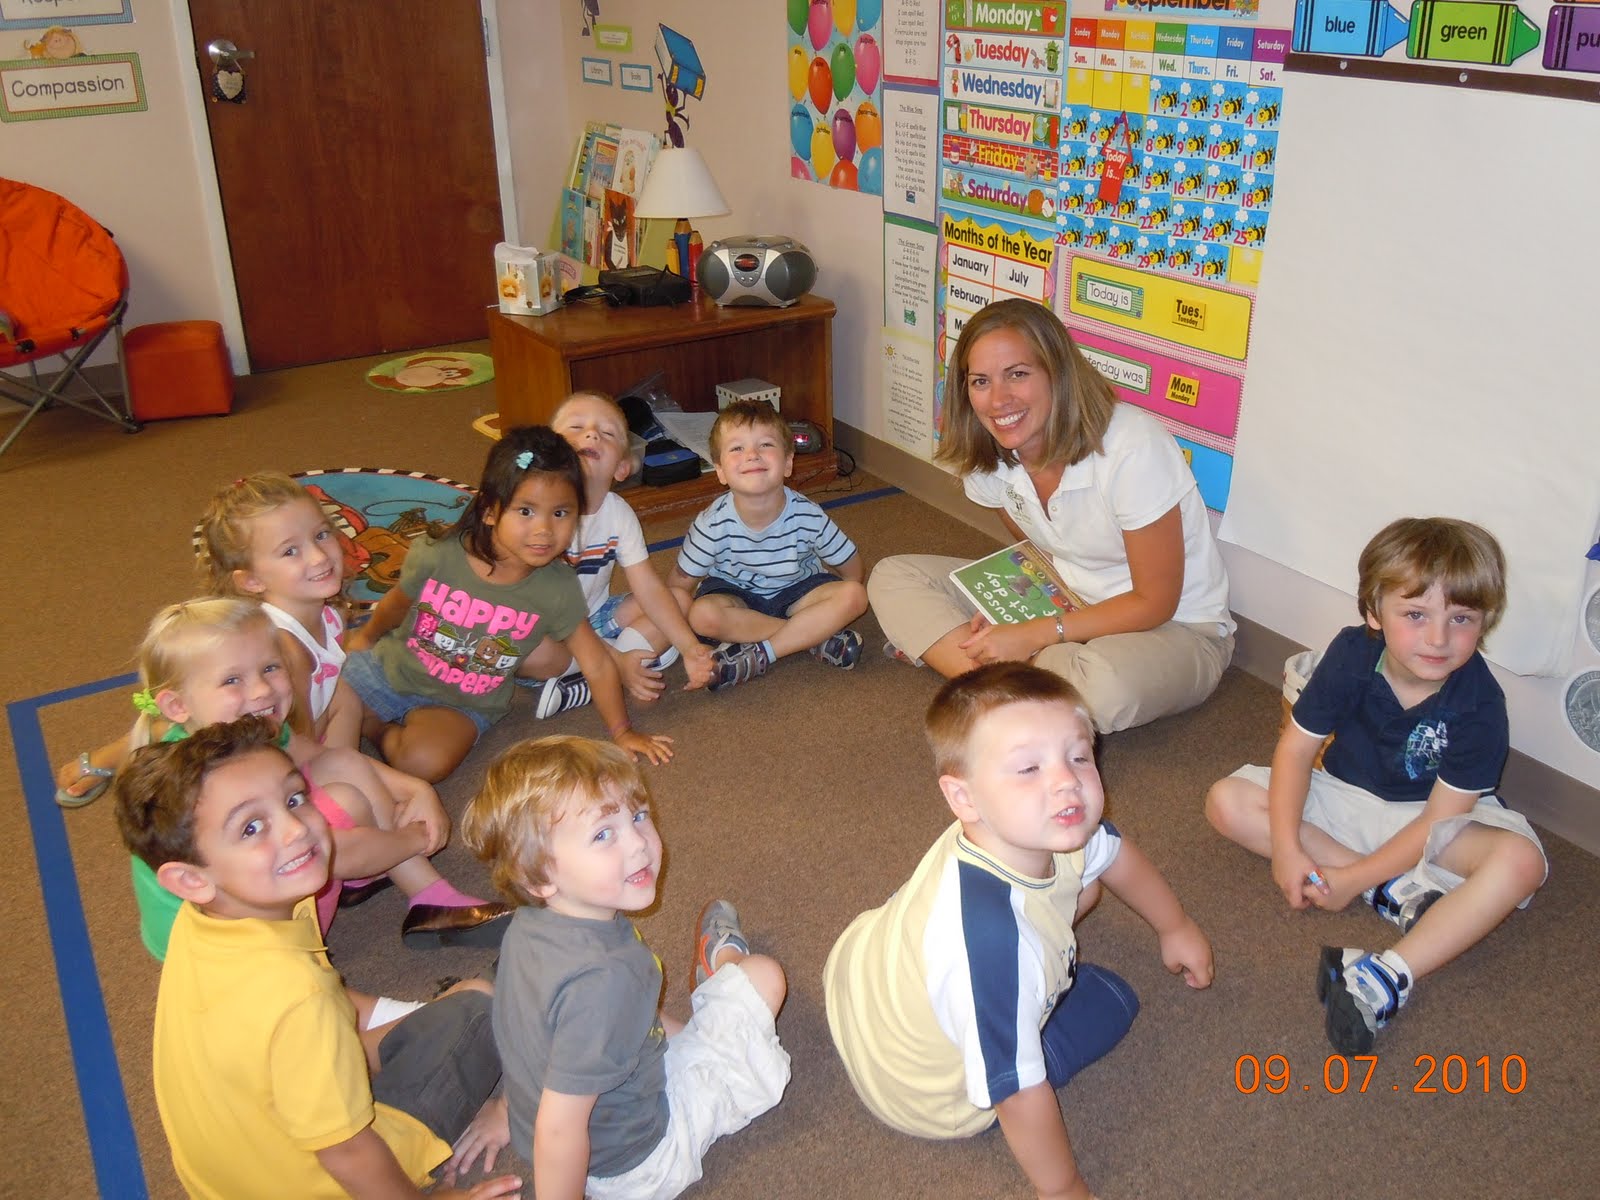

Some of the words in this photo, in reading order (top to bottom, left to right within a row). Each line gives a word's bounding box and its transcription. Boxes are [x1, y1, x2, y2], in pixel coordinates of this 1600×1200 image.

[975, 1, 1032, 31] Monday
[1325, 16, 1355, 33] blue
[1074, 28, 1091, 38] Sunday
[1101, 29, 1120, 40] Monday
[1156, 31, 1185, 45] Wednesday
[1190, 34, 1214, 47] Thursday
[1226, 37, 1244, 49] Friday
[1257, 39, 1285, 53] Saturday
[1440, 23, 1487, 43] green
[974, 38, 1030, 67] Tuesday
[1074, 52, 1088, 64] Sun.
[1100, 54, 1117, 66] Mon.
[1159, 59, 1177, 72] Wed.
[1188, 61, 1210, 75] Thurs.
[1226, 64, 1238, 78] Fri.
[1260, 67, 1276, 81] Sat.
[11, 75, 125, 101] Compassion
[962, 72, 1042, 106] Wednesday
[969, 109, 1031, 140] Thursday
[1180, 102, 1188, 117] 2
[1211, 104, 1219, 118] 3
[1245, 113, 1254, 127] 4
[979, 144, 1019, 170] Friday
[1063, 126, 1069, 139] 5
[1090, 131, 1097, 143] 6
[1146, 139, 1153, 152] 8
[1177, 141, 1184, 155] 9
[1208, 144, 1220, 159] 10
[1242, 155, 1253, 170] 11
[1105, 149, 1127, 169] Today
[968, 178, 1028, 209] Saturday
[1060, 163, 1070, 175] 12
[1086, 165, 1096, 177] 13
[1174, 181, 1185, 195] 16
[1206, 185, 1218, 199] 17
[1241, 193, 1253, 207] 18
[1059, 199, 1069, 211] 19
[1083, 202, 1095, 215] 20
[1110, 204, 1120, 218] 21
[1139, 216, 1154, 229] 22
[1172, 224, 1184, 237] 23
[1202, 227, 1215, 241] 24
[1233, 230, 1248, 245] 25
[944, 220, 984, 245] Months
[987, 232, 1000, 250] of
[1002, 236, 1021, 256] the
[1023, 241, 1052, 264] Year
[1055, 232, 1068, 245] 26
[1083, 235, 1095, 248] 27
[1107, 244, 1119, 258] 28
[1138, 255, 1150, 268] 29
[1192, 263, 1204, 277] 31
[952, 253, 989, 276] January
[1009, 268, 1029, 288] July
[950, 285, 990, 307] February
[1089, 283, 1119, 305] Today
[1120, 291, 1129, 306] is
[1176, 299, 1203, 319] Tues.
[1177, 315, 1198, 327] Tuesday
[1123, 370, 1144, 385] was
[1170, 376, 1196, 396] Mon.
[1170, 392, 1190, 403] Monday
[983, 571, 1009, 597] day
